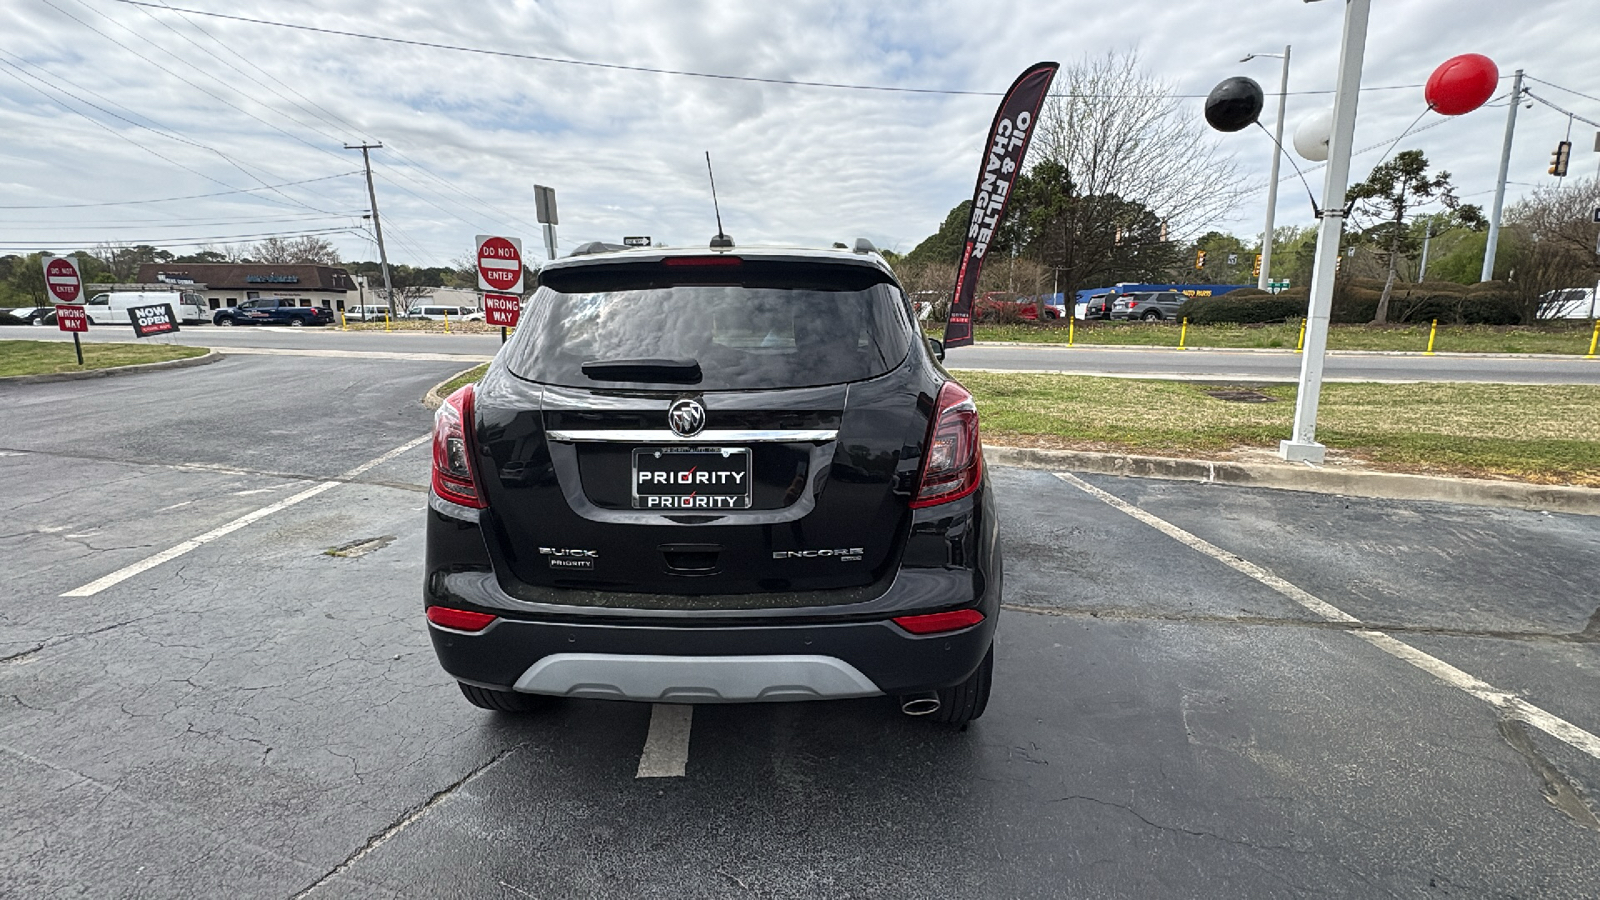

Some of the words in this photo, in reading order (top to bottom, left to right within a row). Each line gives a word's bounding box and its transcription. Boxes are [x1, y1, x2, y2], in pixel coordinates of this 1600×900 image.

[1007, 111, 1031, 152] OIL
[1001, 157, 1016, 175] &
[968, 118, 1013, 238] CHANGES
[971, 179, 1010, 259] FILTER
[483, 246, 495, 256] DO
[498, 247, 515, 258] NOT
[61, 267, 73, 275] NOT
[488, 270, 514, 281] ENTER
[56, 285, 75, 293] ENTER
[1182, 289, 1195, 297] AUTO
[1196, 289, 1212, 297] PARTS
[486, 298, 518, 311] WRONG
[57, 308, 85, 318] WRONG
[134, 306, 166, 318] NOW
[493, 311, 512, 323] WAY
[64, 319, 80, 328] WAY
[138, 315, 170, 326] OPEN
[639, 471, 746, 484] PRIORITY
[648, 496, 737, 508] PRIORITY
[538, 547, 599, 558] BUICK
[773, 547, 864, 559] ENCORE
